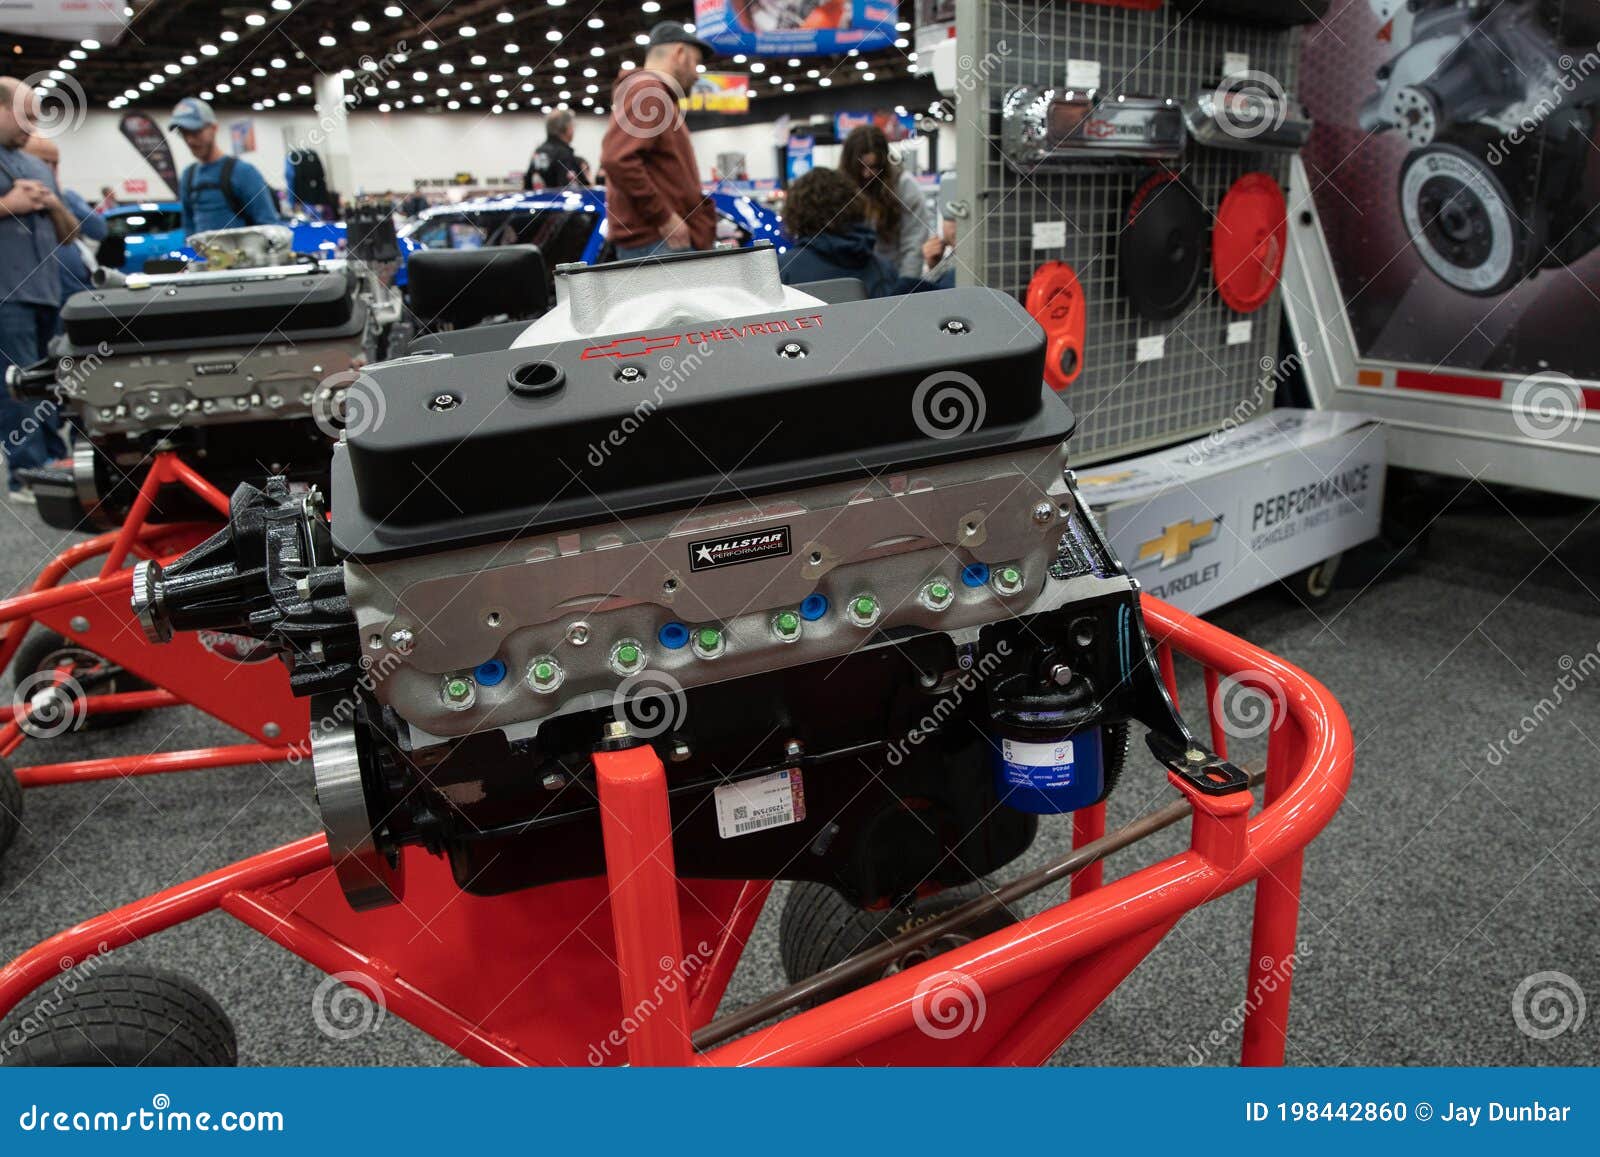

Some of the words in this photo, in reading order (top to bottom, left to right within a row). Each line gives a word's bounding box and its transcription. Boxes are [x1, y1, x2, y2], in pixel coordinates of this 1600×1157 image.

[686, 314, 823, 346] CHEVROLET
[1253, 464, 1371, 531] PERFORMANCE
[711, 533, 783, 552] ALLSTAR
[712, 542, 785, 560] PERFORMANCE
[1149, 561, 1221, 599] EVROLET
